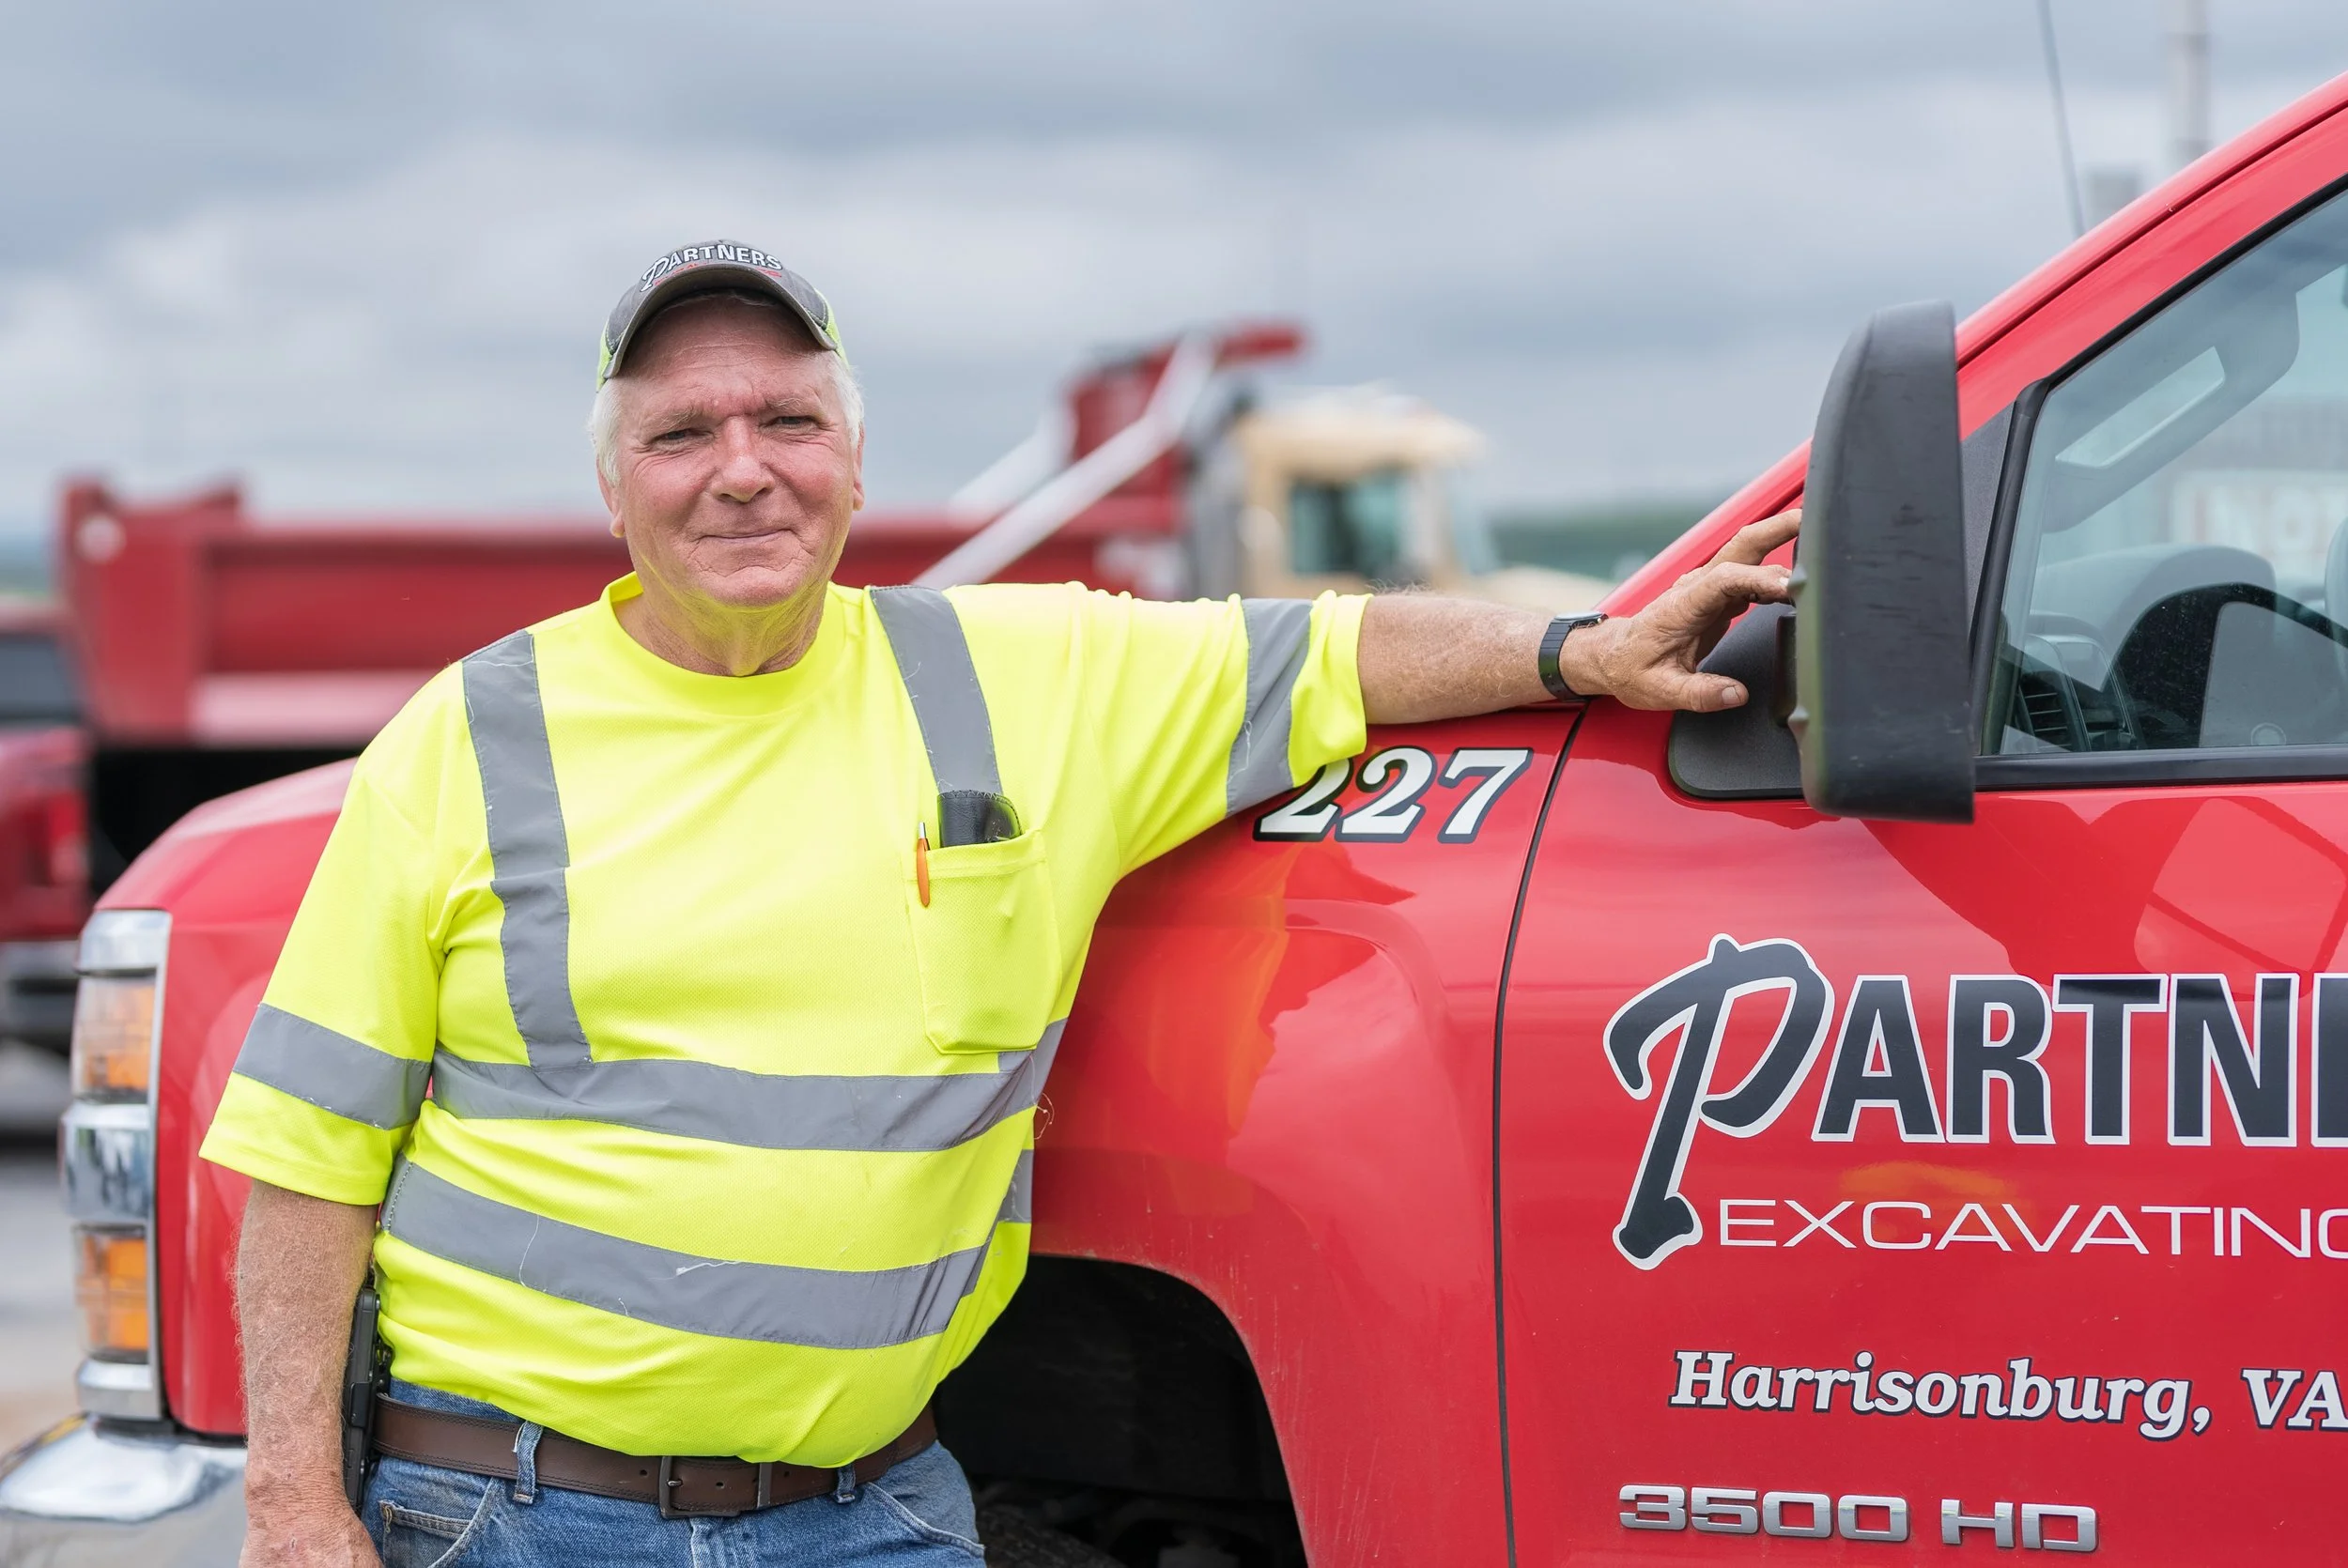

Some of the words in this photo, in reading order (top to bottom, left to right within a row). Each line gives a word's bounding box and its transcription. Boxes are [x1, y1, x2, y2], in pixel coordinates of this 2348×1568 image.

[640, 244, 782, 292] PARTNERS
[1253, 746, 1533, 843] 227
[1668, 1349, 2212, 1442] Harrisonburg,
[2240, 1368, 2348, 1432] VA
[1619, 1483, 1911, 1543] 3500
[1941, 1499, 2099, 1552] HD
